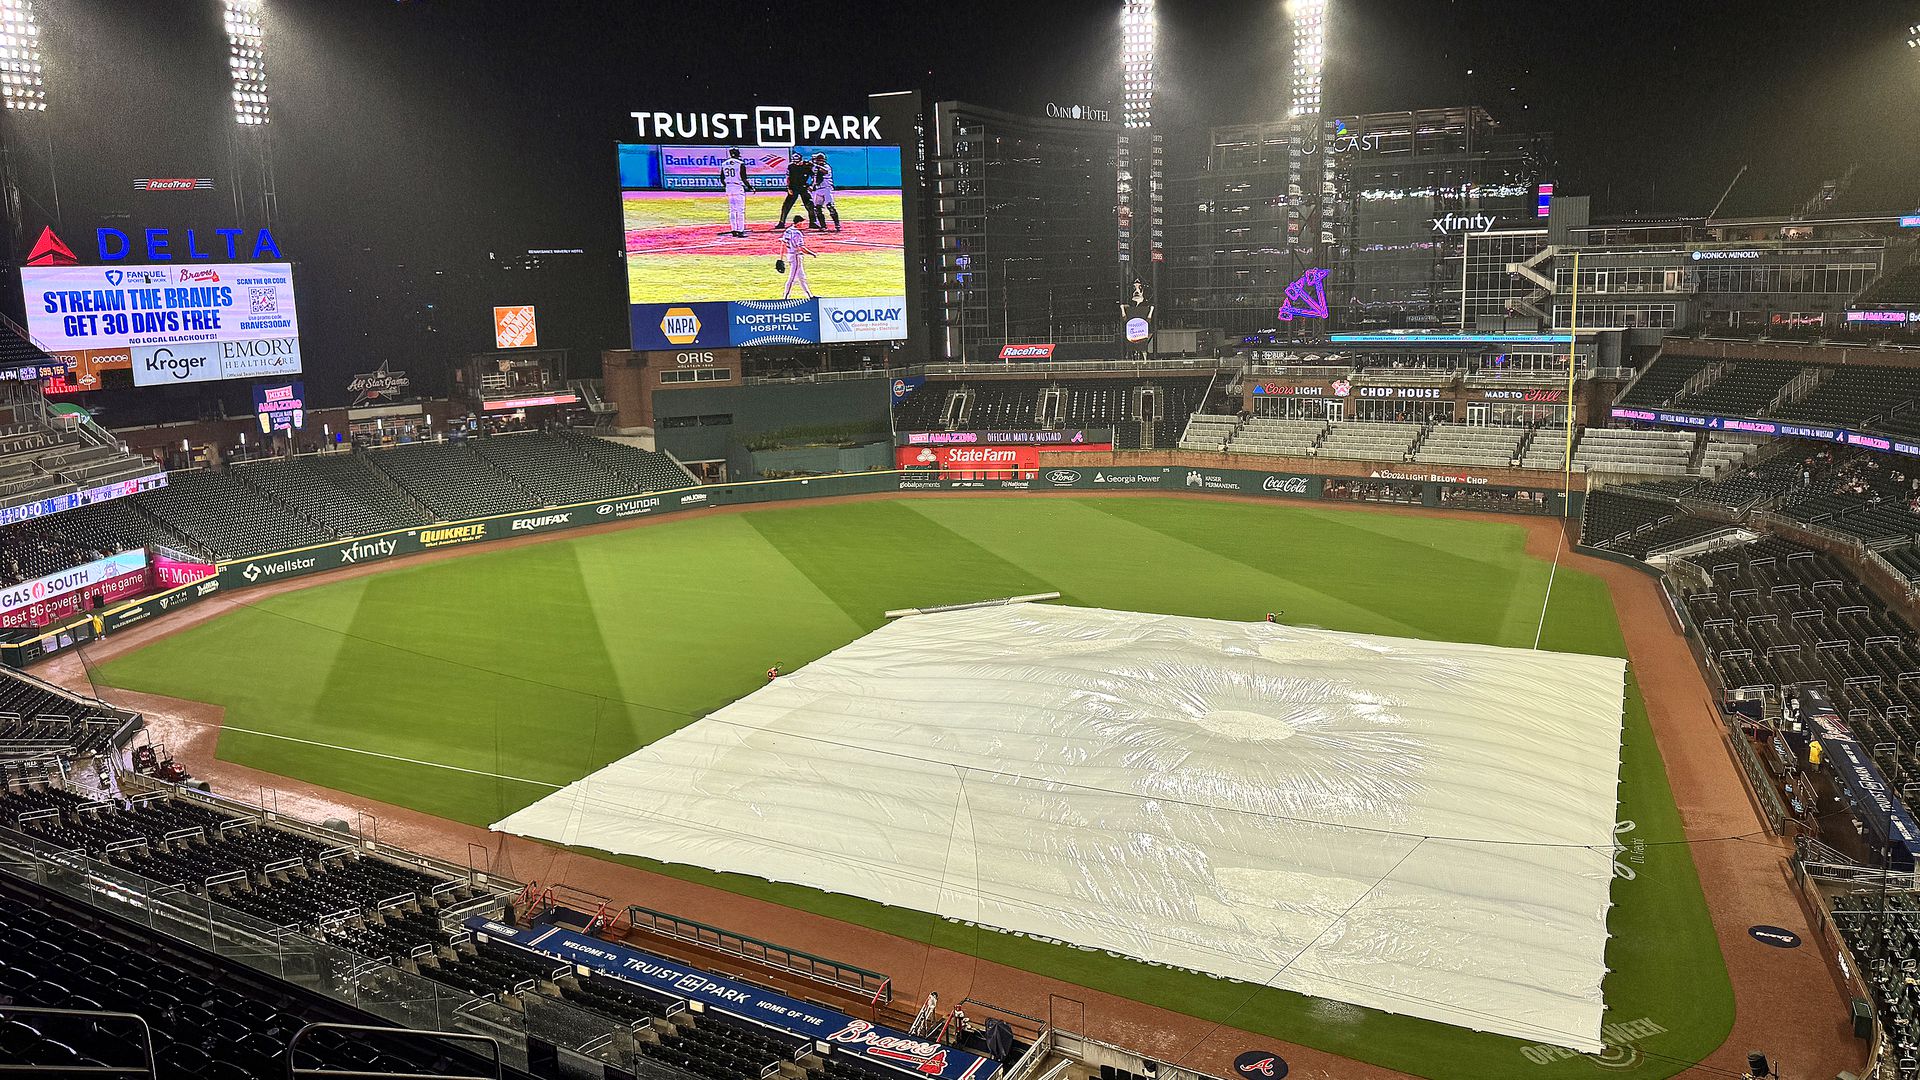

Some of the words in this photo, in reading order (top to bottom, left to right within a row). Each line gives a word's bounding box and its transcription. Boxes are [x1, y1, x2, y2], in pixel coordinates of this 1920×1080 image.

[630, 111, 748, 139] TRUIST
[803, 114, 882, 140] PARK
[665, 155, 697, 166] Bank
[697, 154, 708, 166] of
[724, 168, 736, 178] 30
[150, 180, 192, 189] RaceTrac
[1432, 212, 1496, 234] xfinity
[97, 227, 282, 261] DELTA
[1701, 252, 1728, 260] KONICA
[179, 268, 214, 282] Braves
[43, 289, 126, 314] STREAM
[128, 288, 162, 310] THE
[165, 286, 232, 309] BRAVES
[736, 312, 812, 324] NORTHSIDE
[831, 307, 902, 324] COOLRAY
[64, 314, 98, 337] GET
[102, 314, 128, 335] 30
[132, 311, 179, 334] DAYS
[182, 309, 222, 331] FREE
[240, 320, 291, 330] BRAVES30DAY
[498, 306, 534, 347] HOME
[667, 318, 696, 336] NAPA
[750, 324, 799, 332] HOSPITAL
[169, 334, 218, 343] BLACKOUTS!
[223, 338, 295, 358] EMORY
[1004, 346, 1049, 356] RaceTrac
[145, 348, 207, 379] Kroger
[226, 356, 294, 369] HEALTHCARE
[676, 352, 714, 364] ORIS
[366, 378, 384, 388] Star
[384, 376, 408, 388] Game
[1265, 382, 1294, 395] Coors
[1295, 386, 1322, 396] LIGHT
[1360, 387, 1393, 396] CHOP
[1398, 388, 1440, 398] HOUSE
[1524, 388, 1562, 401] Chill
[258, 400, 302, 412] AMAZING
[929, 432, 977, 443] AMAZING
[987, 432, 1012, 442] OFFICIAL
[1052, 471, 1075, 481] Ford
[1106, 474, 1136, 484] Georgia
[1138, 474, 1160, 483] Power
[1380, 469, 1406, 480] Coors
[1430, 474, 1457, 483] BELOW
[1466, 476, 1488, 485] CHOP
[1262, 475, 1310, 494] Coca-Cola
[616, 498, 660, 512] HYUNDAI
[512, 513, 572, 530] EQUIFAX
[420, 524, 486, 543] QUIKRETE
[340, 538, 398, 563] xfinity
[263, 557, 316, 576] Wellstar
[158, 567, 169, 582] T
[172, 567, 208, 584] Mobil
[2, 588, 30, 608] GAS
[47, 570, 89, 594] SOUTH
[2, 610, 26, 628] Best
[29, 604, 44, 618] 5G
[45, 592, 90, 613] coverae
[91, 587, 100, 597] in
[101, 582, 116, 595] the
[118, 574, 143, 591] game
[562, 940, 602, 957] WELCOME
[604, 952, 618, 961] TO
[622, 957, 684, 982] TRUIST
[700, 982, 752, 1004] PARK
[756, 1000, 788, 1014] HOME
[787, 1010, 802, 1018] OF
[802, 1014, 824, 1026] THE
[826, 1018, 942, 1057] Braves
